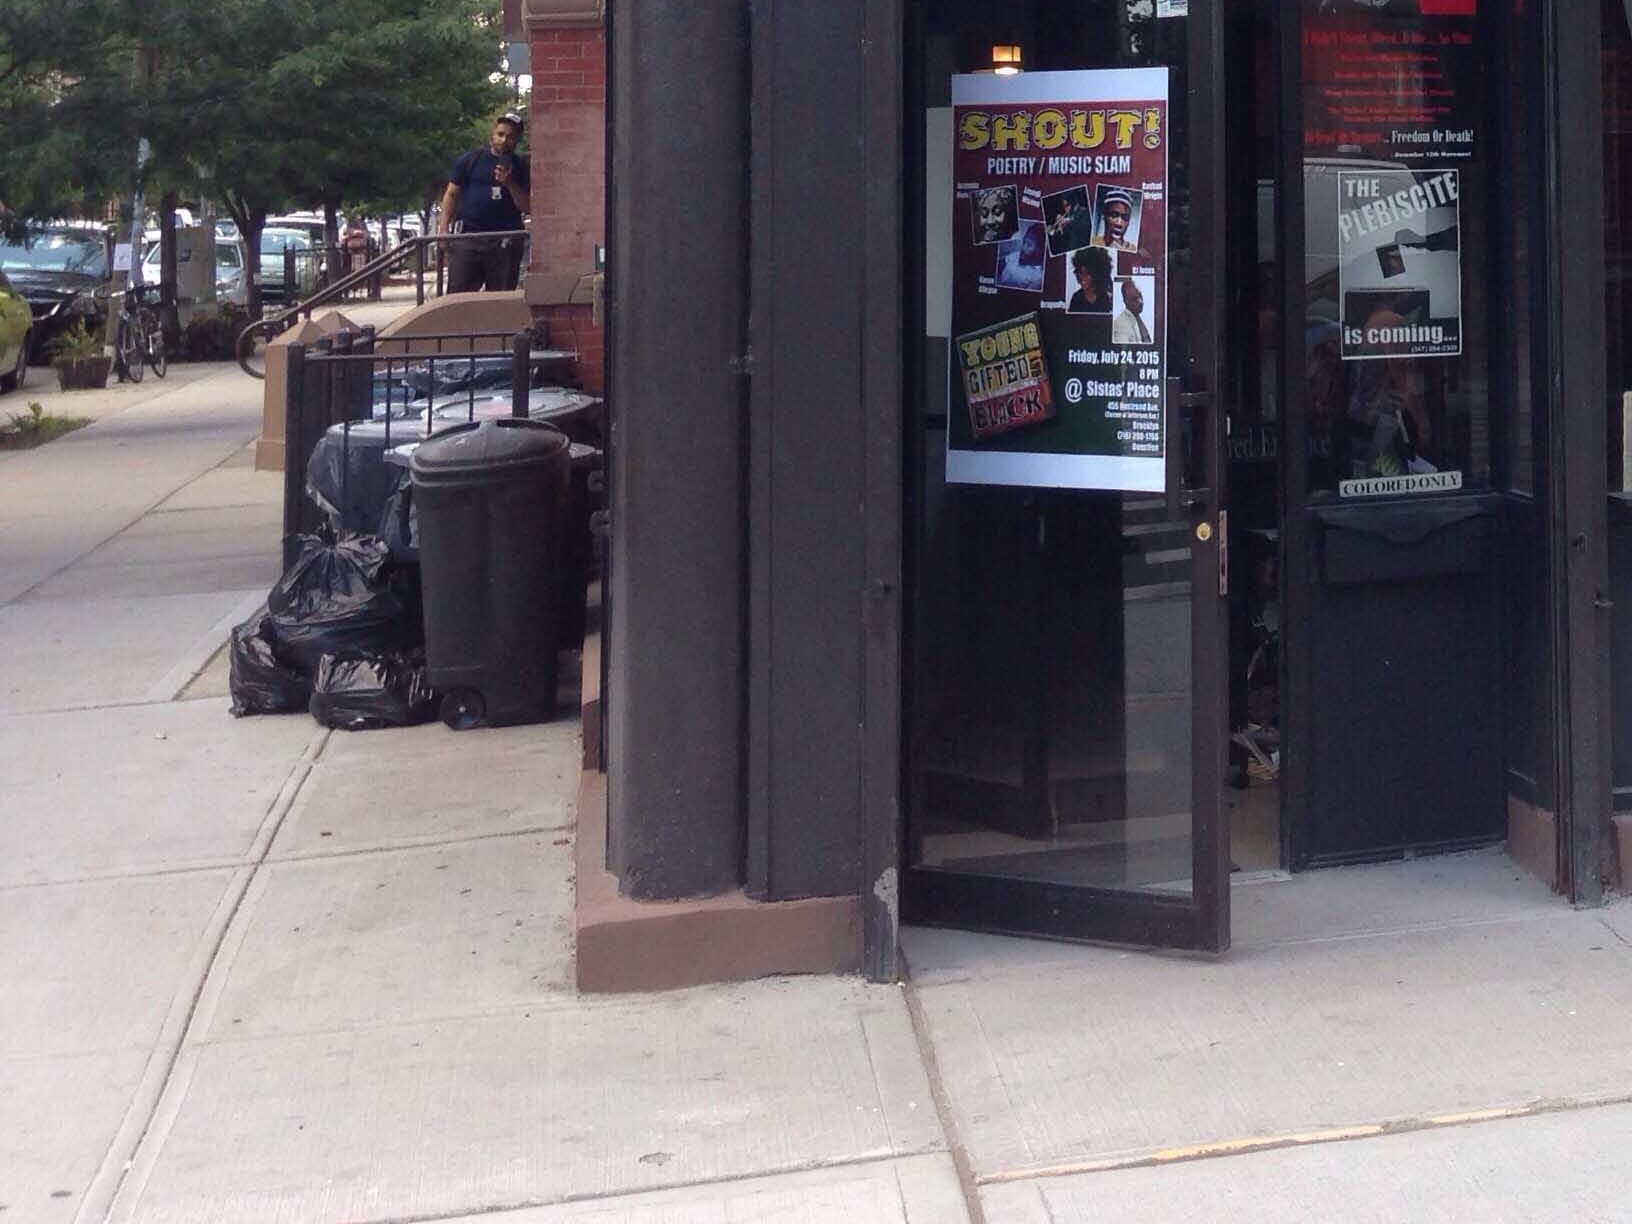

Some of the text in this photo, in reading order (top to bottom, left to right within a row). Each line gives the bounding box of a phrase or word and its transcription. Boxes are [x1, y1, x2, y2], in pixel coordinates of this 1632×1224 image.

[959, 107, 1161, 151] SHOUT!
[1392, 129, 1430, 144] Freedom
[1433, 129, 1443, 143] Or
[1445, 129, 1474, 143] Death!
[987, 156, 1036, 175] POETRY
[1049, 155, 1092, 175] MUSIC
[1095, 155, 1131, 174] SLAM
[1345, 179, 1380, 198] THE
[1340, 172, 1458, 242] PLEBISCITE
[961, 322, 1040, 366] YOUNG
[1344, 324, 1457, 344] is coming...
[1068, 350, 1099, 364] Friday,
[1101, 350, 1119, 365] July
[1136, 351, 1160, 365] 2015
[969, 358, 1029, 394] GIFTED
[1086, 381, 1125, 397] Sistas'
[1127, 381, 1160, 398] Place
[973, 390, 1044, 430] BLACK
[1343, 473, 1460, 495] COLORED ONLY
